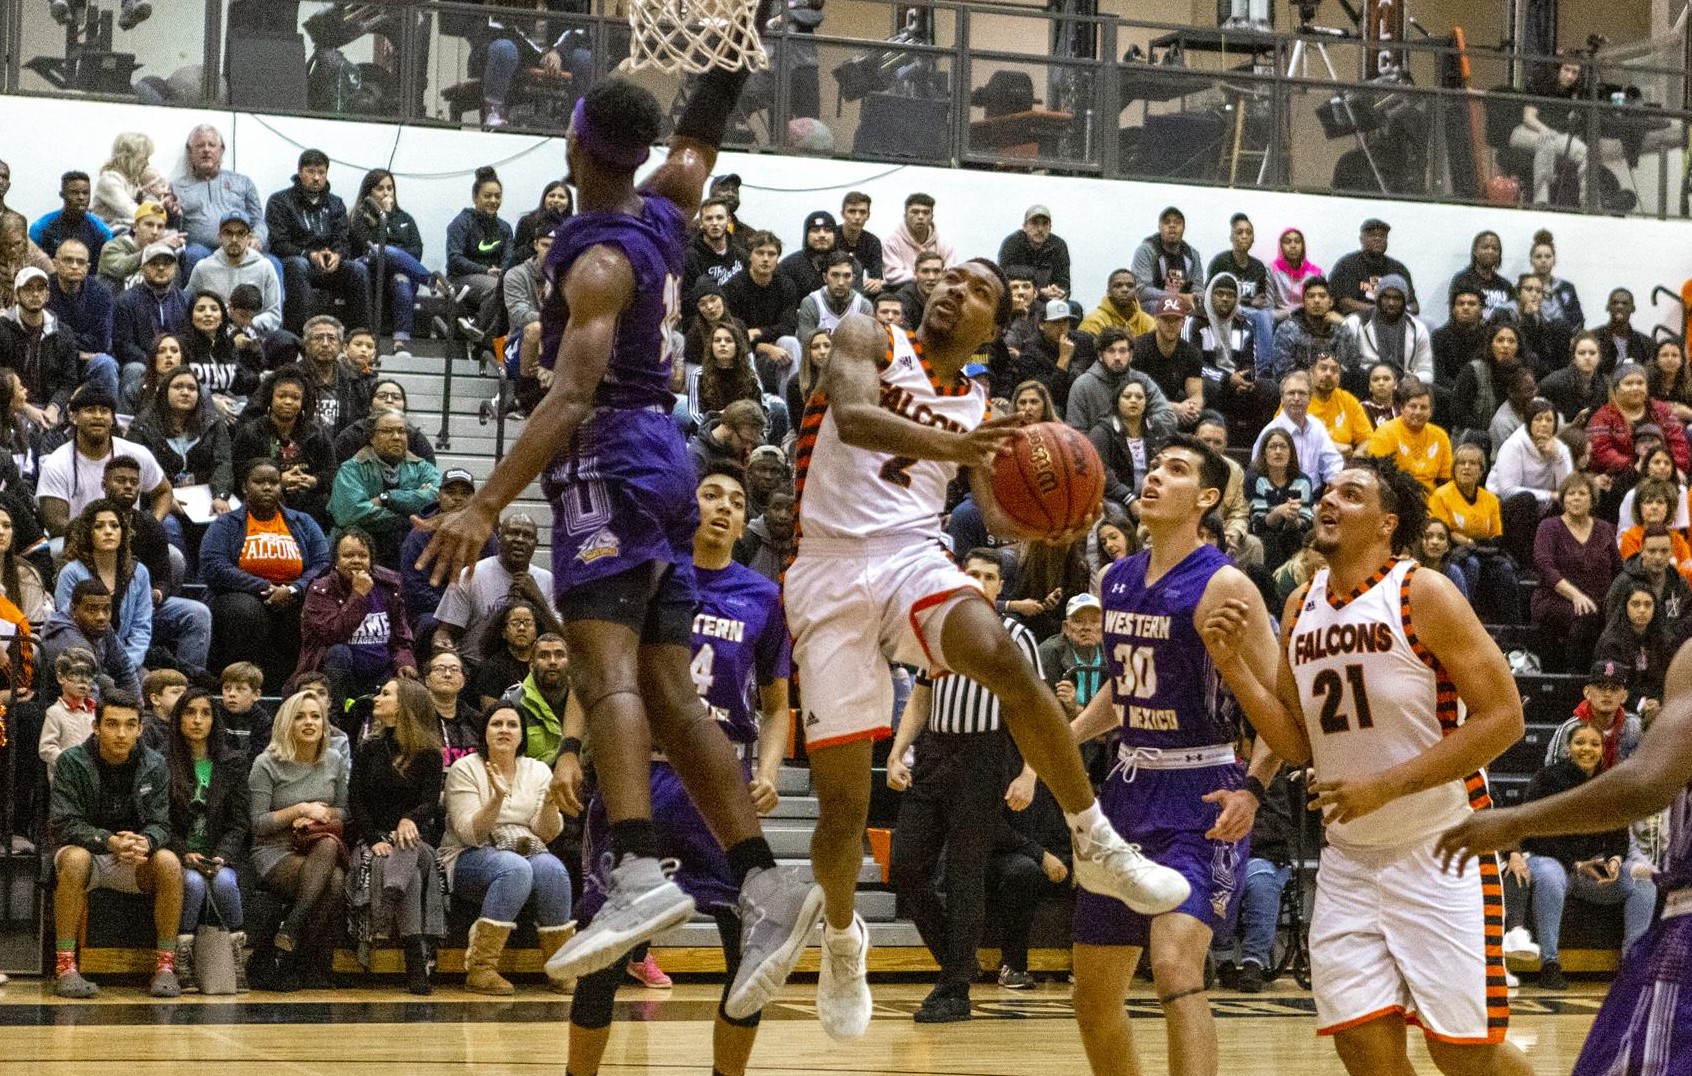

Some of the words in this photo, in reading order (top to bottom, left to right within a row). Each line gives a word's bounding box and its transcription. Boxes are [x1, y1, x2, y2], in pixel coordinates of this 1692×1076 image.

[878, 456, 919, 488] 2
[692, 613, 745, 642] TERN
[1105, 610, 1171, 640] WESTERN
[1294, 622, 1394, 666] FALCONS
[1113, 643, 1157, 700] 30
[1312, 664, 1374, 736] 21
[1129, 705, 1179, 730] MEXICO
